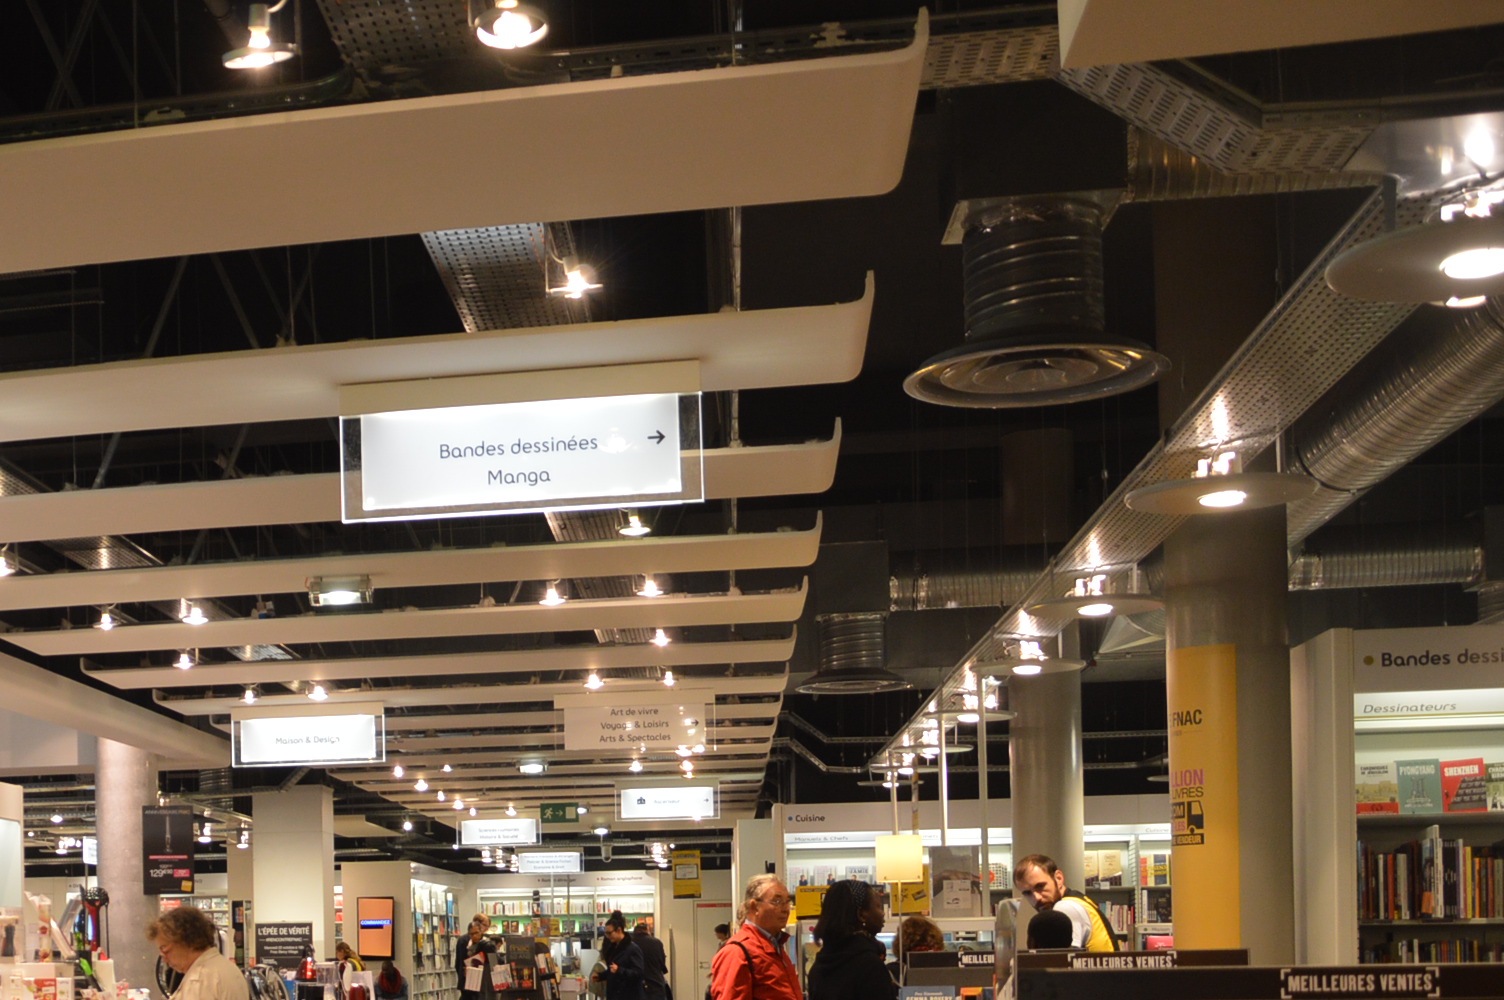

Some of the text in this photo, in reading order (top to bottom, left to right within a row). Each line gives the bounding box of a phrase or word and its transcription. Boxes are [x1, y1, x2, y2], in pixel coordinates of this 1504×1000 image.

[439, 435, 598, 459] Bandes dessinées
[488, 469, 551, 487] Manga
[1382, 650, 1451, 667] Bandes
[610, 708, 624, 716] Art
[638, 707, 659, 715] vivre
[1363, 703, 1457, 714] Dessinateurs
[1173, 709, 1203, 727] FNAC
[601, 721, 632, 730] Voyag
[643, 720, 669, 728] Loisirs
[276, 737, 303, 745] Maison
[600, 735, 616, 743] Arts
[627, 733, 671, 743] Spectacles
[1399, 765, 1435, 776] PYONGYANG
[1444, 765, 1479, 777] SHENZHEN
[795, 814, 825, 822] Cuisine
[258, 926, 278, 936] L'ÉPÉE
[288, 926, 310, 936] VÉRITÉ
[1073, 955, 1172, 969] MEILLEURES VENTES
[1288, 974, 1433, 993] MEILLEURES VENTES
